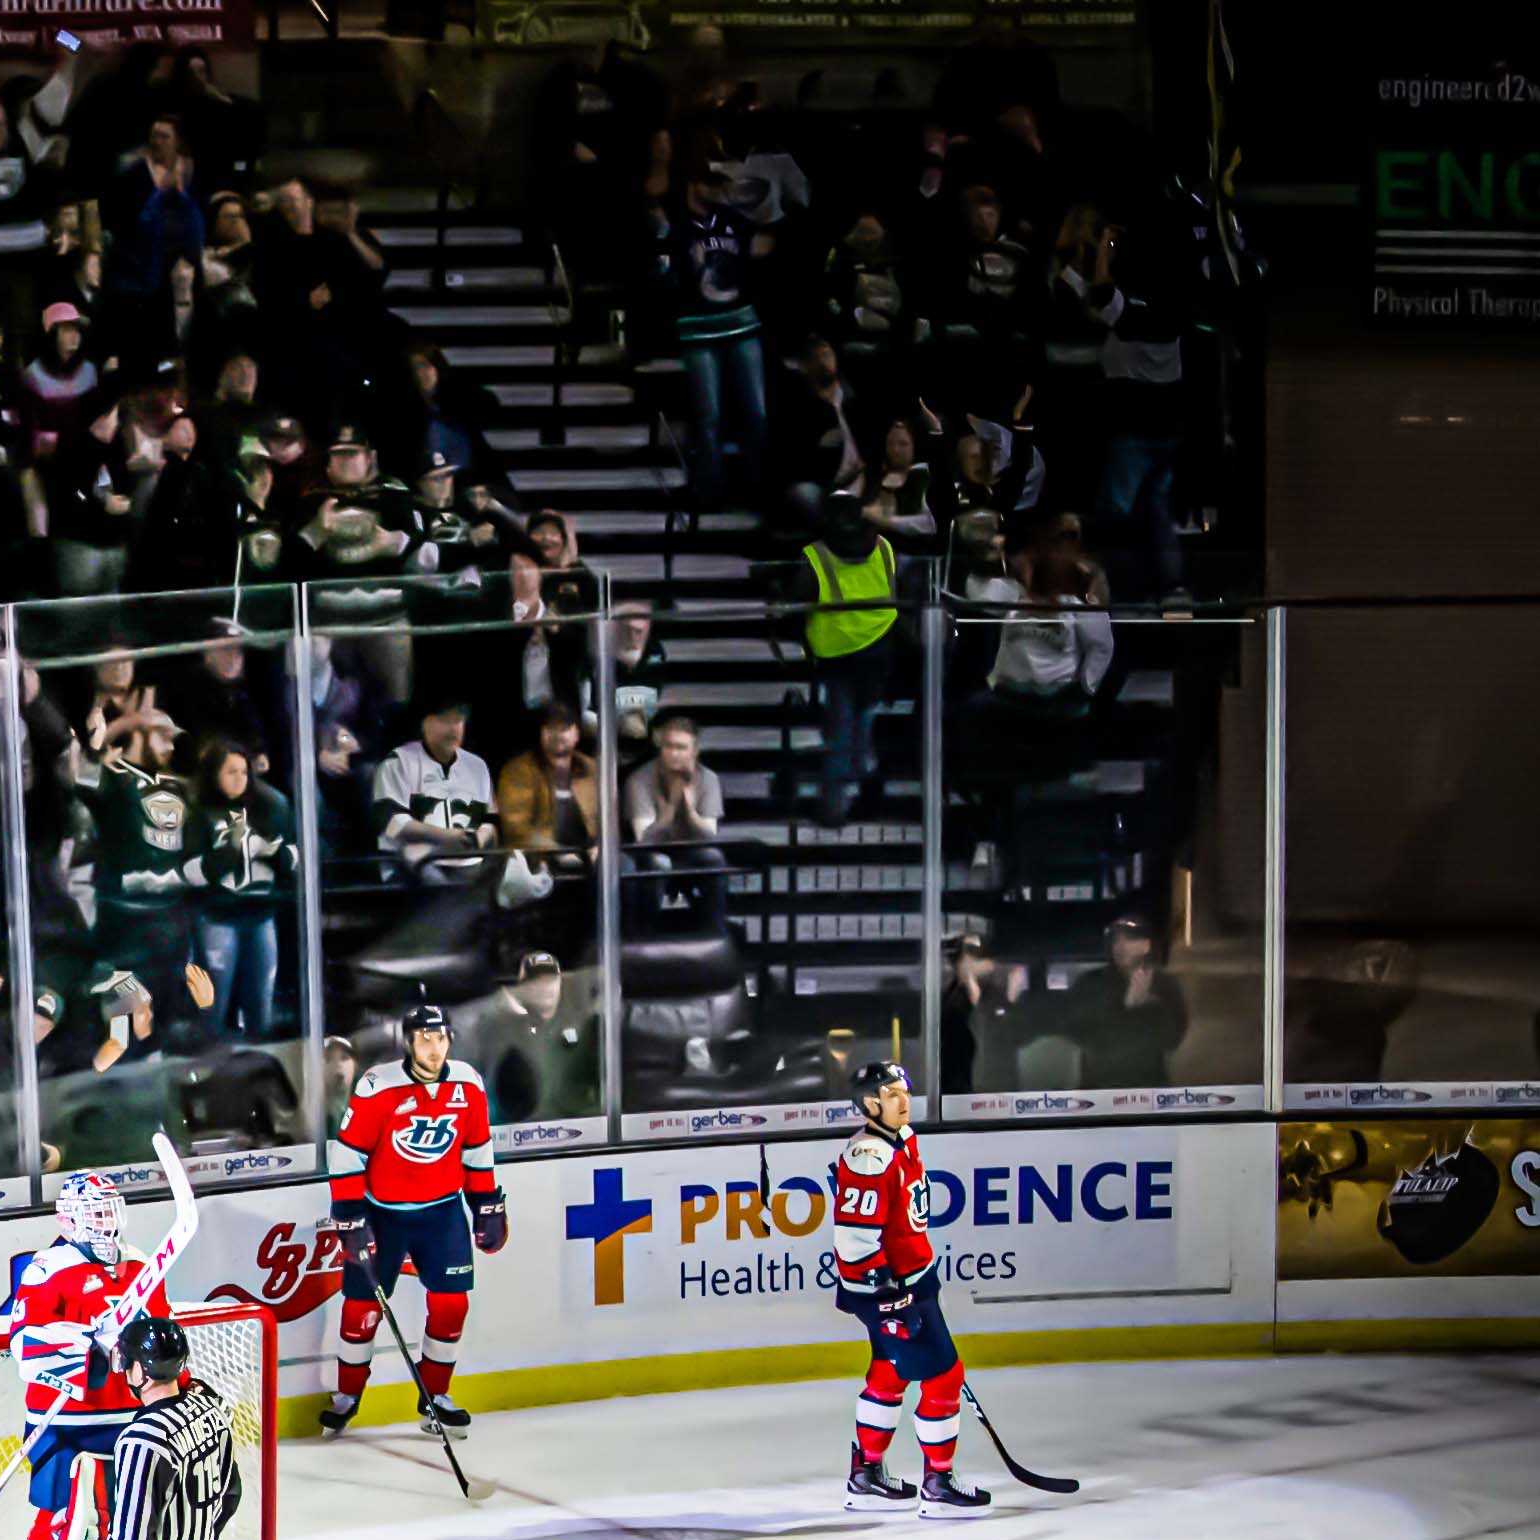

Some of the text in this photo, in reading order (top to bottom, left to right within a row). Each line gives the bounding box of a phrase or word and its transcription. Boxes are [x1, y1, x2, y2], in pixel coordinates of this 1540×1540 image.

[1373, 287, 1458, 316] Physical
[451, 1083, 466, 1102] A
[1157, 1089, 1213, 1109] gerber
[1350, 1084, 1408, 1104] gerber
[825, 1103, 860, 1123] gerb
[1015, 1093, 1072, 1113] gerber
[691, 1111, 749, 1131] gerber
[513, 1126, 568, 1146] gerber
[224, 1153, 277, 1175] gerber
[681, 1160, 1174, 1245] PRODENCE
[840, 1188, 878, 1216] 20
[681, 1252, 805, 1298] Health
[934, 1244, 1017, 1281] ices
[113, 1238, 175, 1326] CCM
